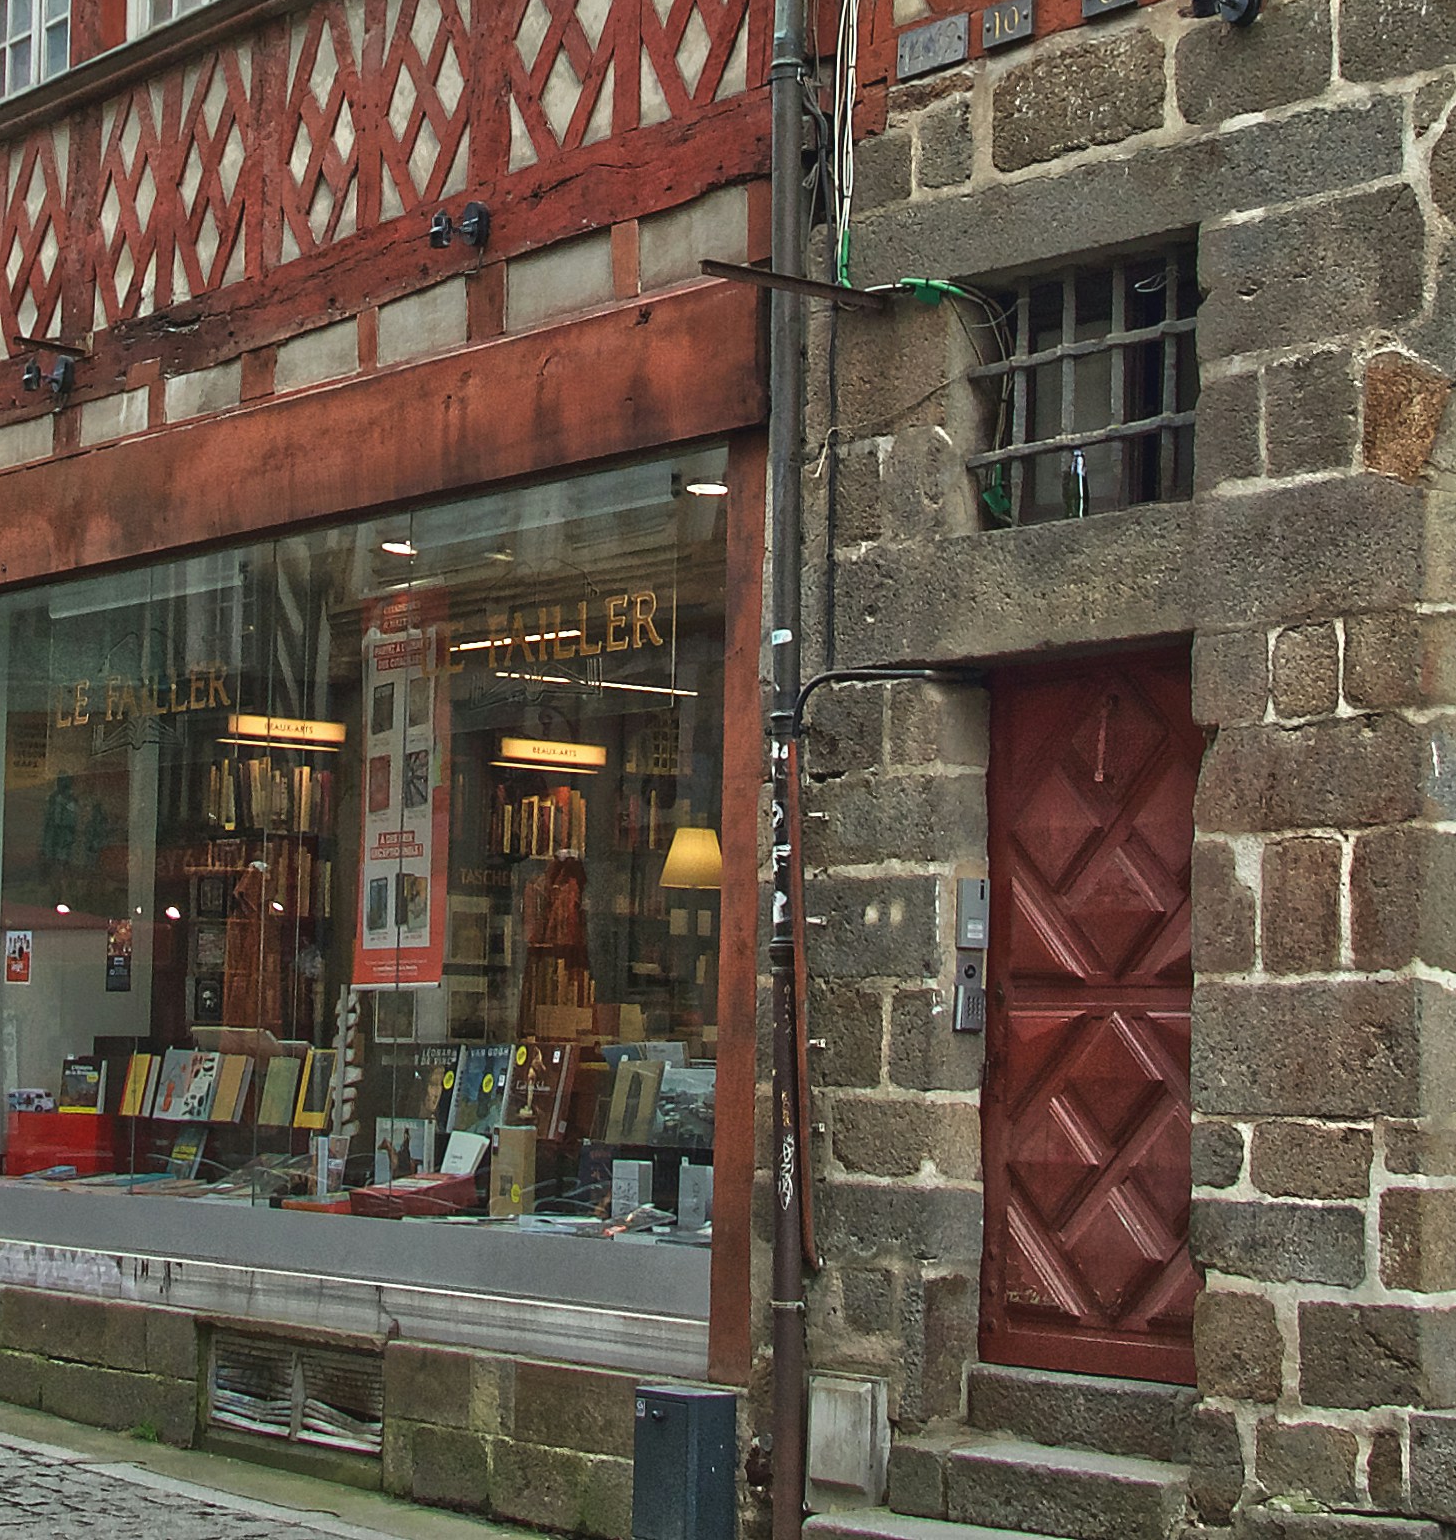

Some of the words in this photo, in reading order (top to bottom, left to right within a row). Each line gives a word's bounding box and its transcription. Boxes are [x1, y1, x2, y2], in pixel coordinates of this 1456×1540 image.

[994, 6, 1019, 38] 10
[421, 622, 465, 678] LE
[487, 591, 664, 669] FAILLER
[55, 678, 90, 729] LE
[104, 664, 232, 722] FAILLER
[532, 746, 578, 758] BEAUX-ARTS
